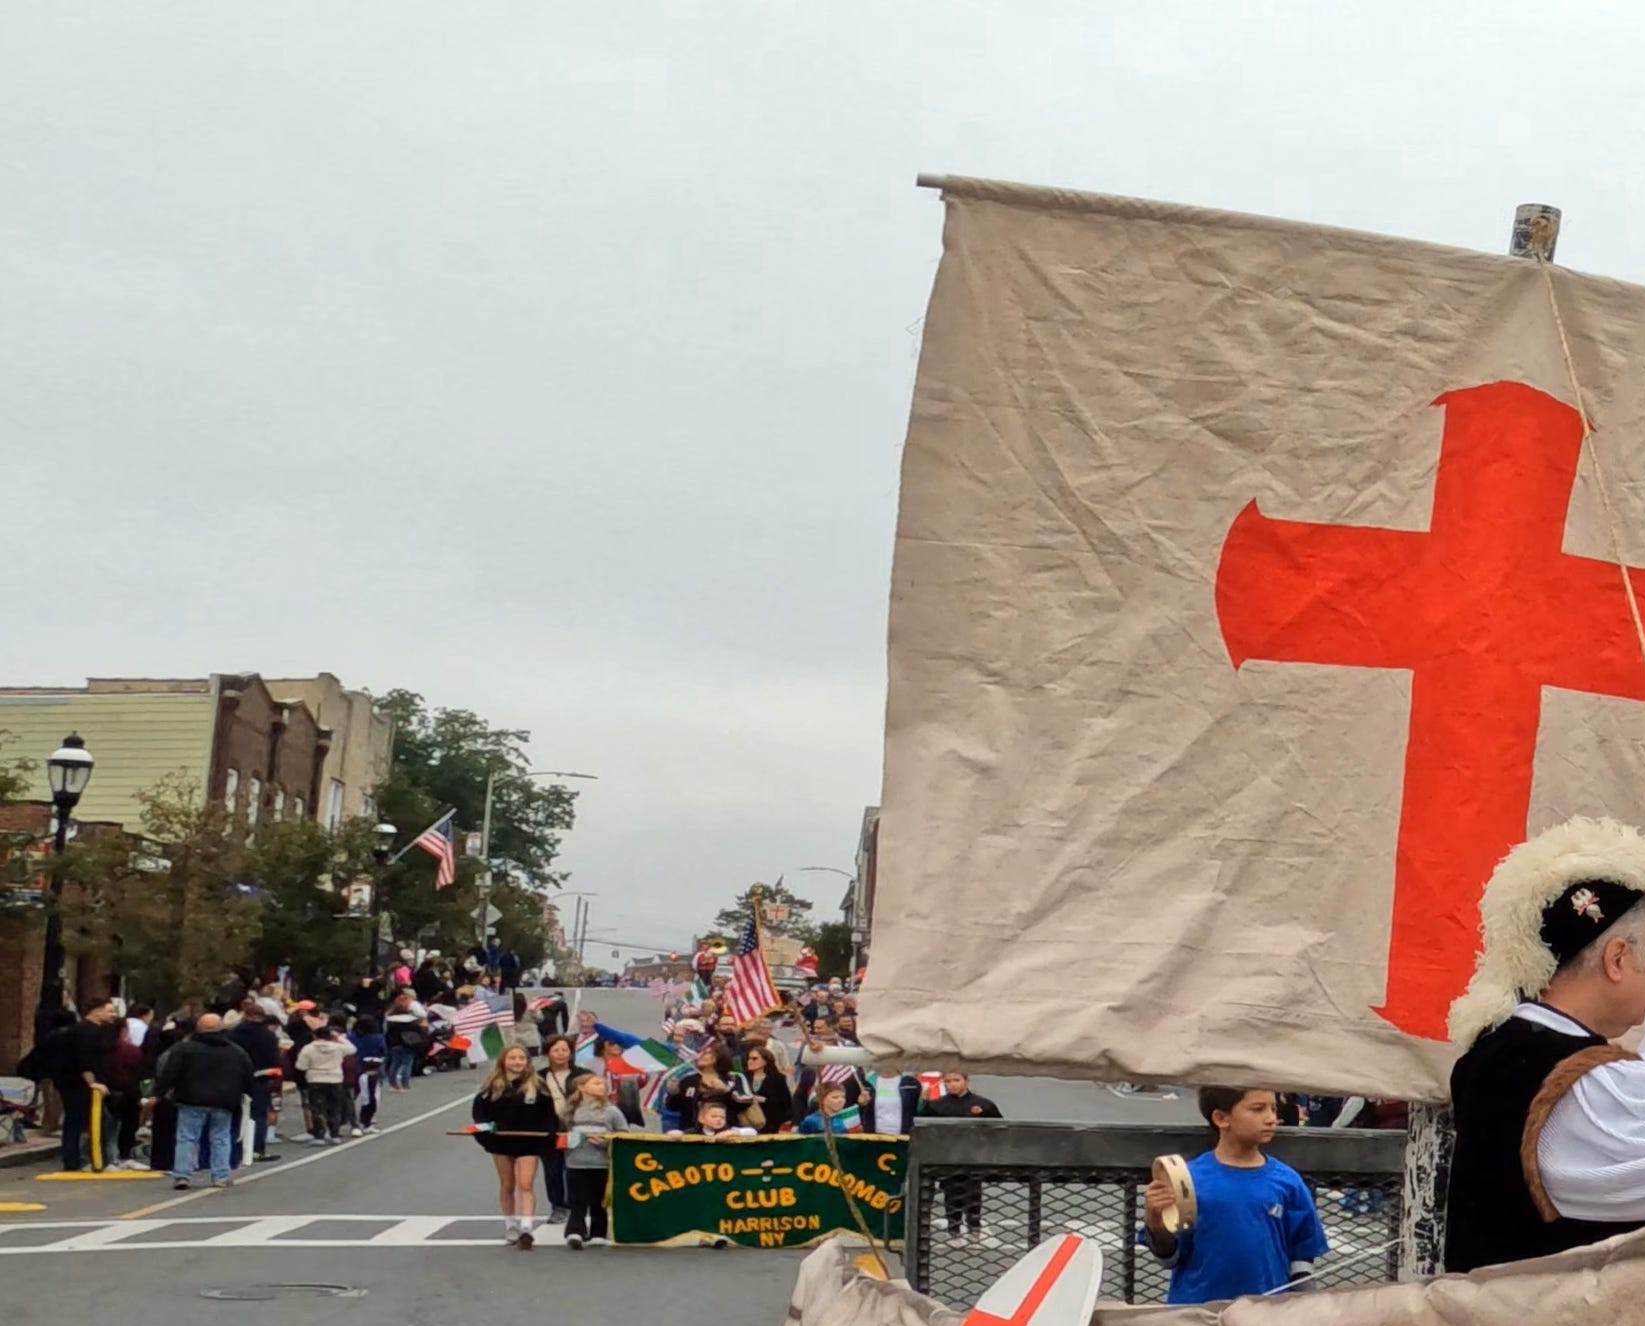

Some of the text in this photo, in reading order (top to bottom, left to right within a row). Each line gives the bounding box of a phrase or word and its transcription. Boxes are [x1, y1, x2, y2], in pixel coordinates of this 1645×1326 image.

[634, 1152, 663, 1172] G.
[877, 1153, 897, 1176] C.
[628, 1161, 902, 1214] CABOTO COLOMBO
[726, 1187, 796, 1209] CLUB
[719, 1214, 820, 1233] HARRISON
[759, 1231, 785, 1246] NY
